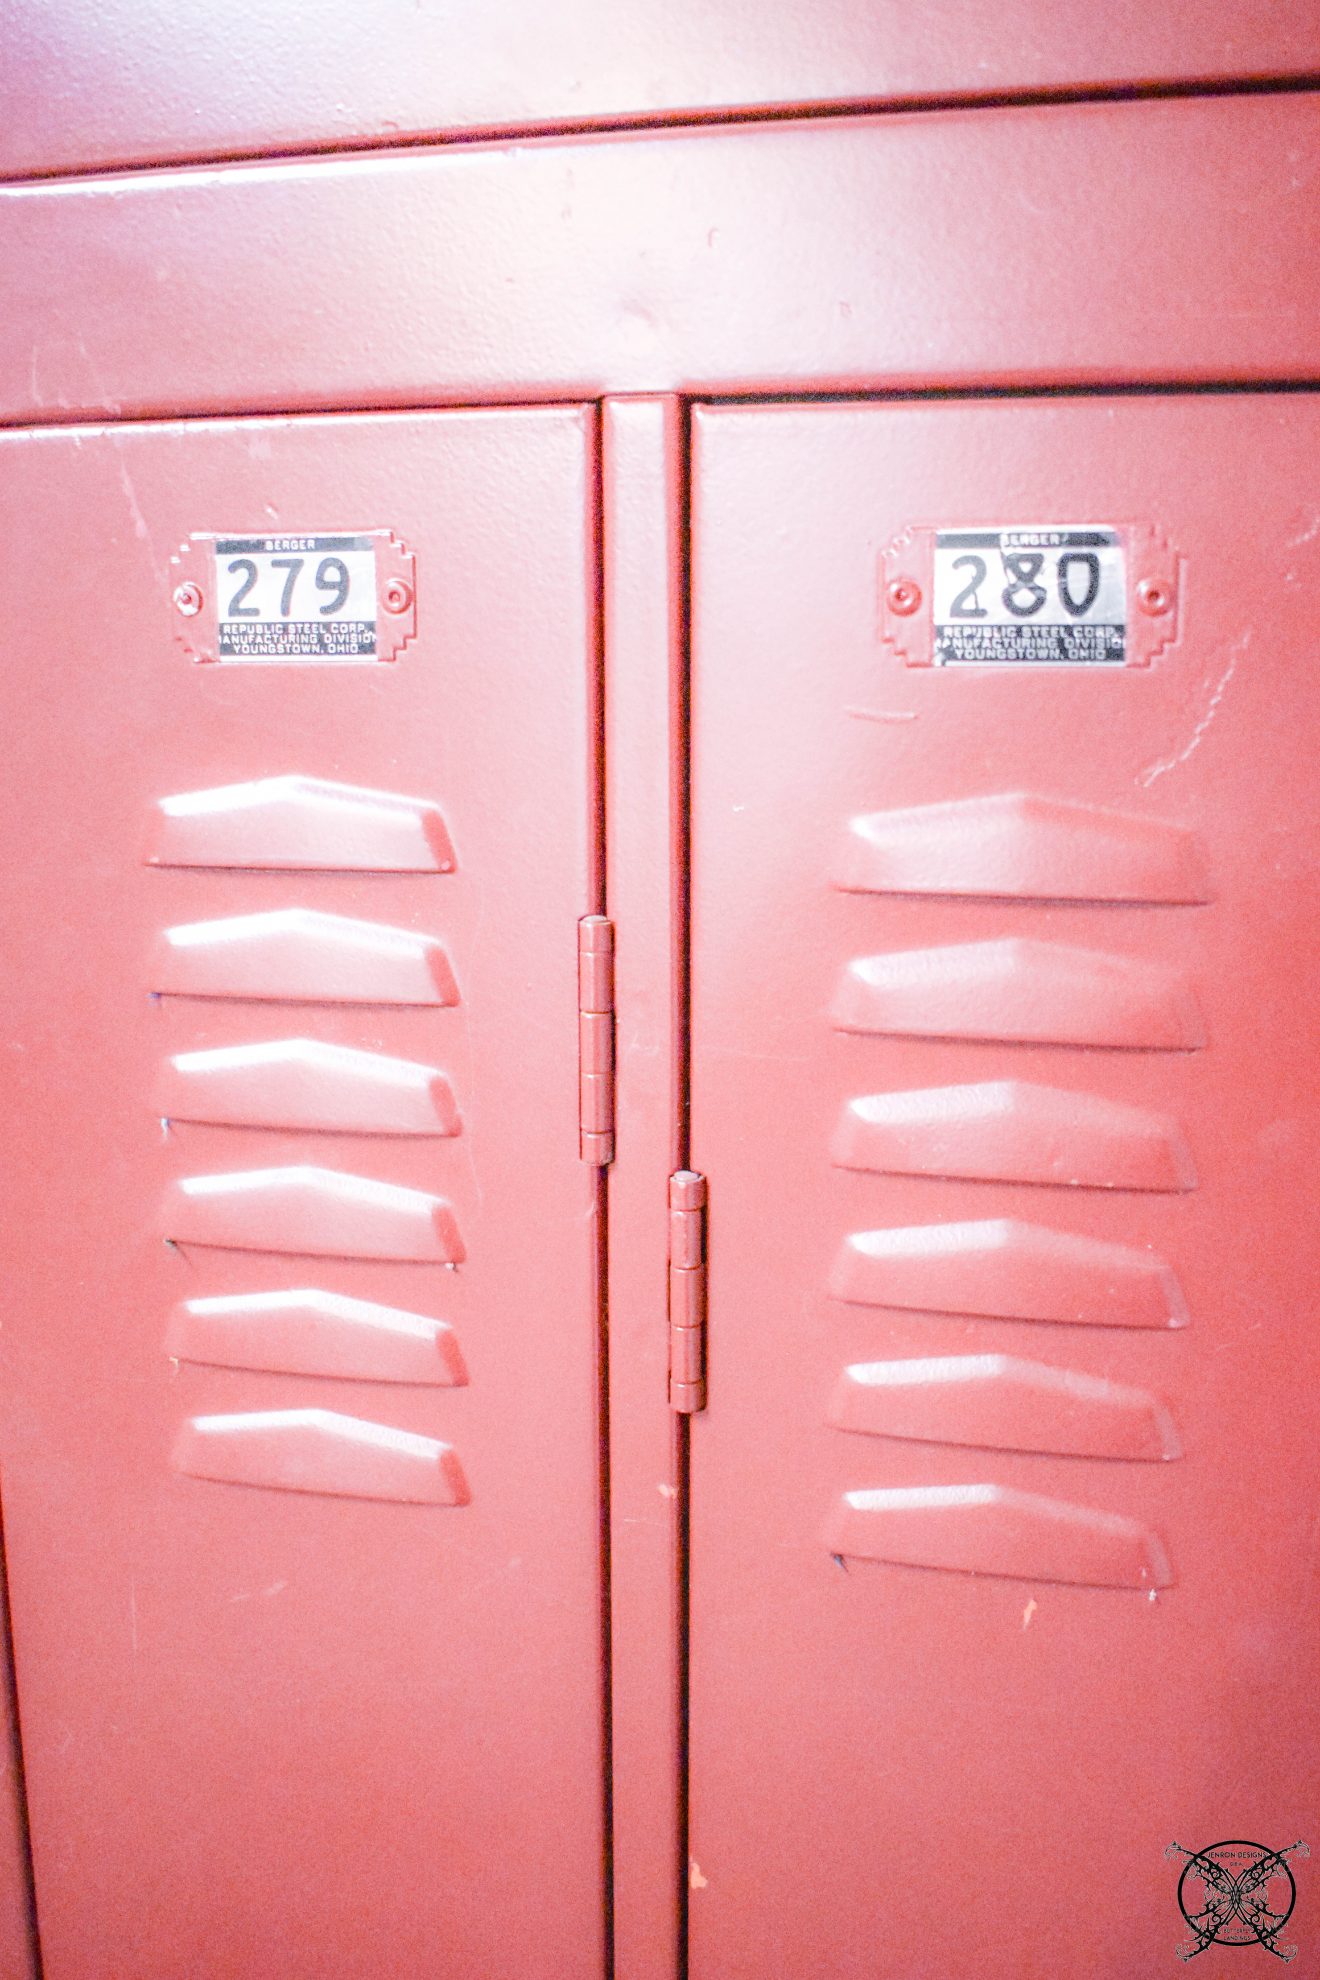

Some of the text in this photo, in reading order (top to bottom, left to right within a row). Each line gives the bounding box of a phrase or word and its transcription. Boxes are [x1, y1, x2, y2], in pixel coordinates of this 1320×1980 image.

[264, 539, 317, 551] BERGER
[227, 556, 350, 618] 279
[949, 552, 1100, 618] 280
[223, 623, 283, 635] REPUBLIC
[288, 623, 326, 634] STEEL
[943, 626, 1018, 638] REPUBLIC
[1021, 626, 1067, 638] STEEL
[218, 633, 318, 645] ANUFACTURING
[1063, 637, 1126, 648] DIVISIO
[327, 643, 359, 654] OHIO
[1068, 648, 1106, 660] OHIO
